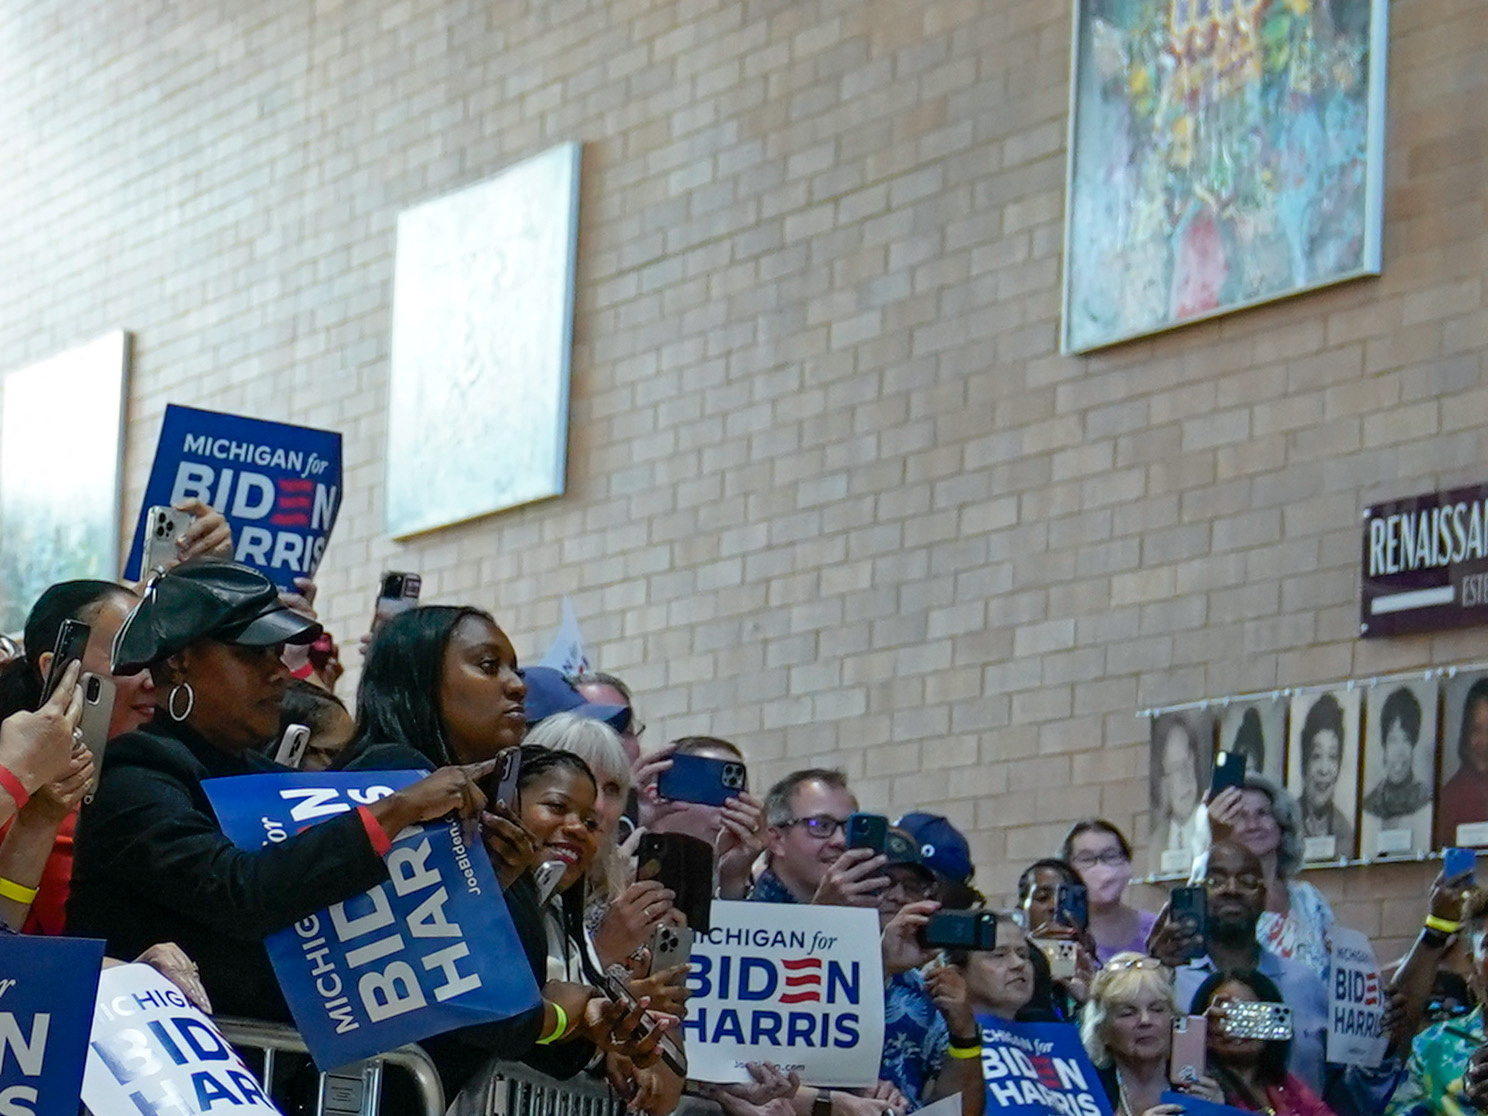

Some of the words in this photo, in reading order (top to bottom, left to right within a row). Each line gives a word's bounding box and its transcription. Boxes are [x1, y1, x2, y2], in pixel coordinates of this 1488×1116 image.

[183, 433, 303, 473] MICHIGAN
[302, 452, 329, 478] for
[170, 461, 337, 531] BIDEN
[234, 527, 327, 574] RRIS
[261, 816, 288, 847] or
[445, 817, 481, 896] JoeBiden.
[387, 825, 483, 1002] HAR
[328, 884, 428, 1023] BID
[807, 931, 838, 955] for
[294, 914, 361, 1034] MICHIG
[687, 953, 861, 1005] BIDEN
[90, 1017, 231, 1086] BID
[681, 1007, 860, 1049] HARRIS
[980, 1046, 1089, 1091] BIDEN
